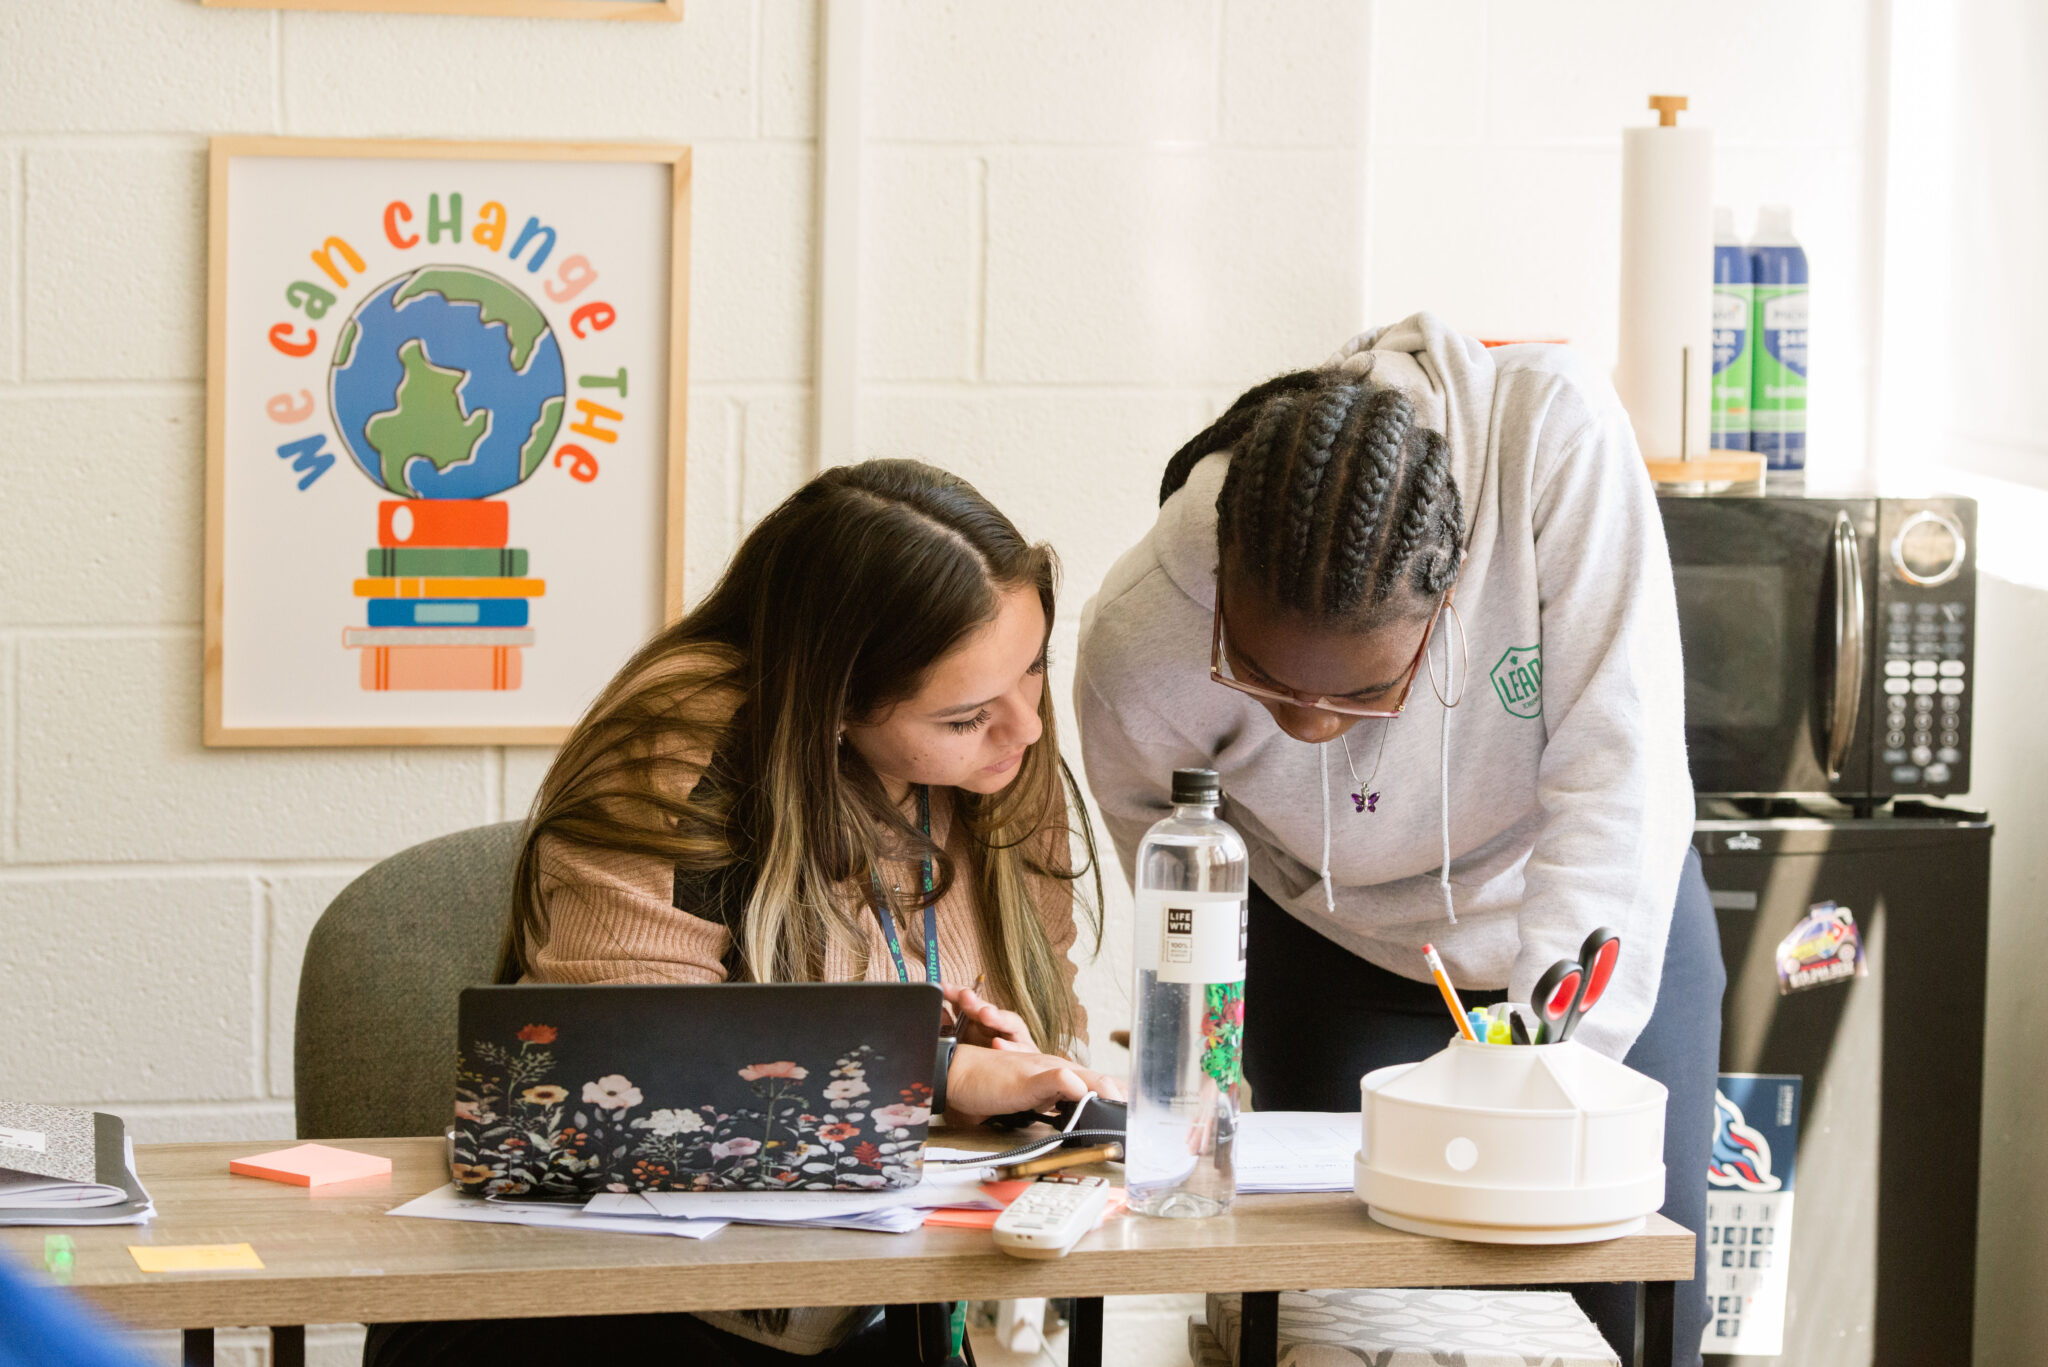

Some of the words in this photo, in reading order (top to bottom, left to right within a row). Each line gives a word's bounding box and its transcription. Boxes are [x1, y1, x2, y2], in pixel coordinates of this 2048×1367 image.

[1169, 912, 1192, 921] LIFE
[1169, 922, 1191, 931] WTR
[928, 939, 938, 984] nthers
